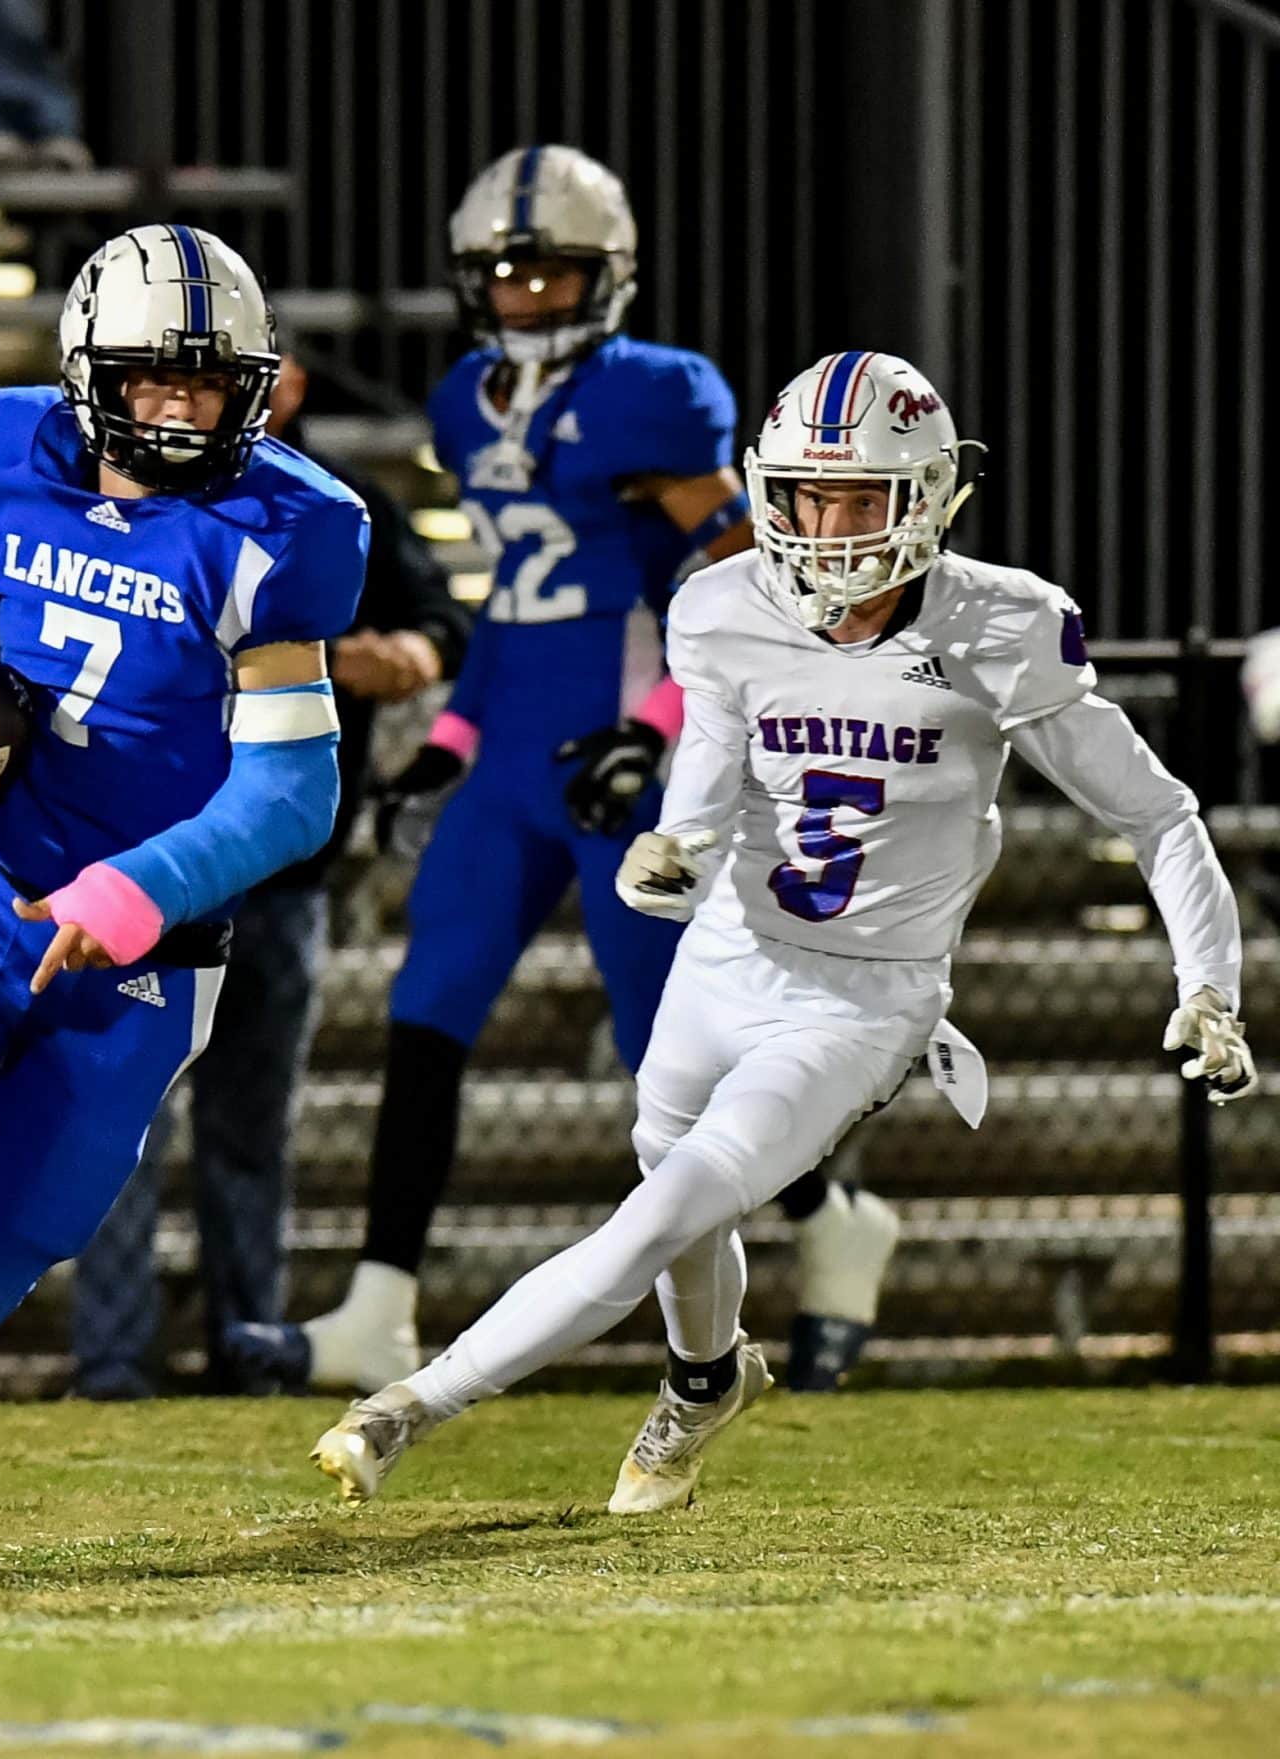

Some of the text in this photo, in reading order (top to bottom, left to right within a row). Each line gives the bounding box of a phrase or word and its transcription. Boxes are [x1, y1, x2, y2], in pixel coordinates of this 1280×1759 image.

[803, 448, 854, 461] Riddell
[3, 533, 186, 624] LANCERS
[39, 600, 123, 748] 7
[758, 717, 944, 764] HERITAGE
[768, 769, 885, 923] 5
